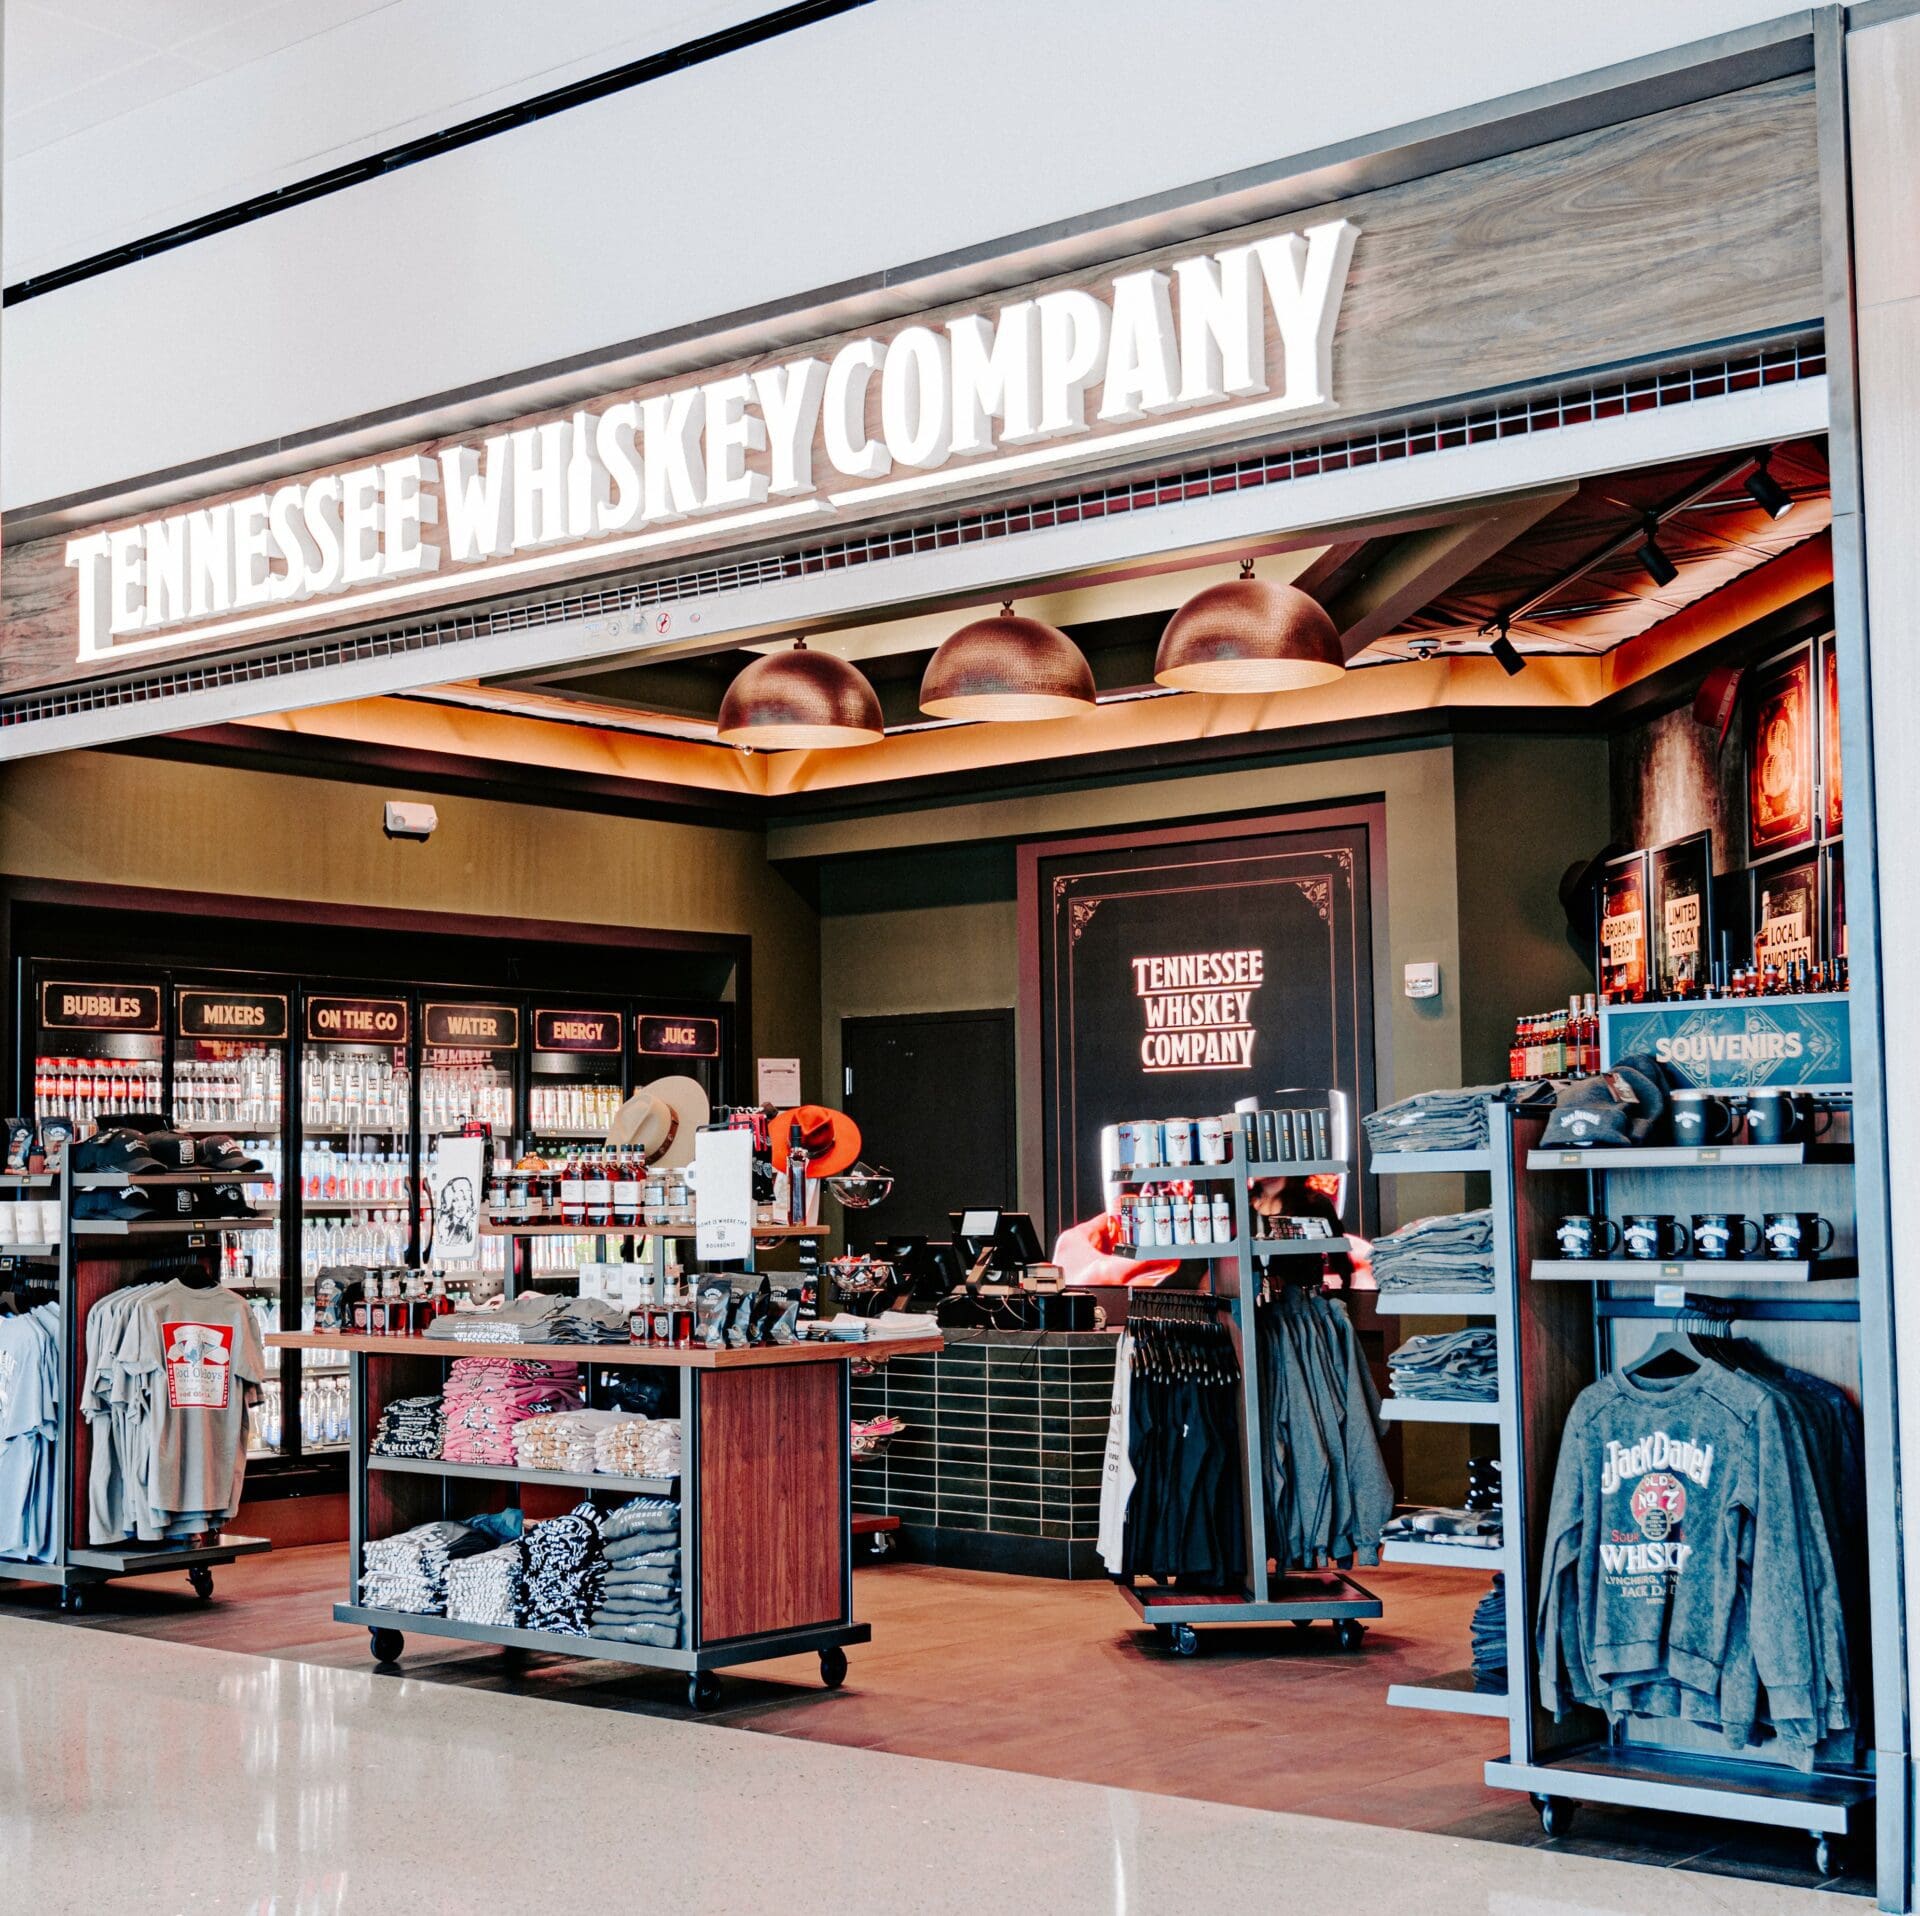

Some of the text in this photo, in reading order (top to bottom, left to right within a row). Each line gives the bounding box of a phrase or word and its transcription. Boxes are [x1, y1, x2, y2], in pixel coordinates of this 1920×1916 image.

[65, 218, 1362, 663] TENNESSEE WHISKEY COMPANY
[1668, 902, 1698, 927] LIMITED
[1605, 918, 1639, 941] BROADWAY
[1671, 926, 1696, 949] STOCK
[1771, 922, 1799, 947] LOCAL
[1613, 940, 1633, 958] READY
[1132, 950, 1264, 996] TENNESSEE
[62, 995, 142, 1018] BUBBLES
[203, 1004, 265, 1026] MIXERS
[1144, 991, 1252, 1028] WHISKEY
[317, 1009, 398, 1031] ON THE GO
[447, 1016, 498, 1037] WATER
[553, 1021, 604, 1041] ENERGY
[661, 1027, 696, 1046] JUICE
[1655, 1031, 1803, 1064] SOUVENIRS
[1141, 1029, 1257, 1068] COMPANY
